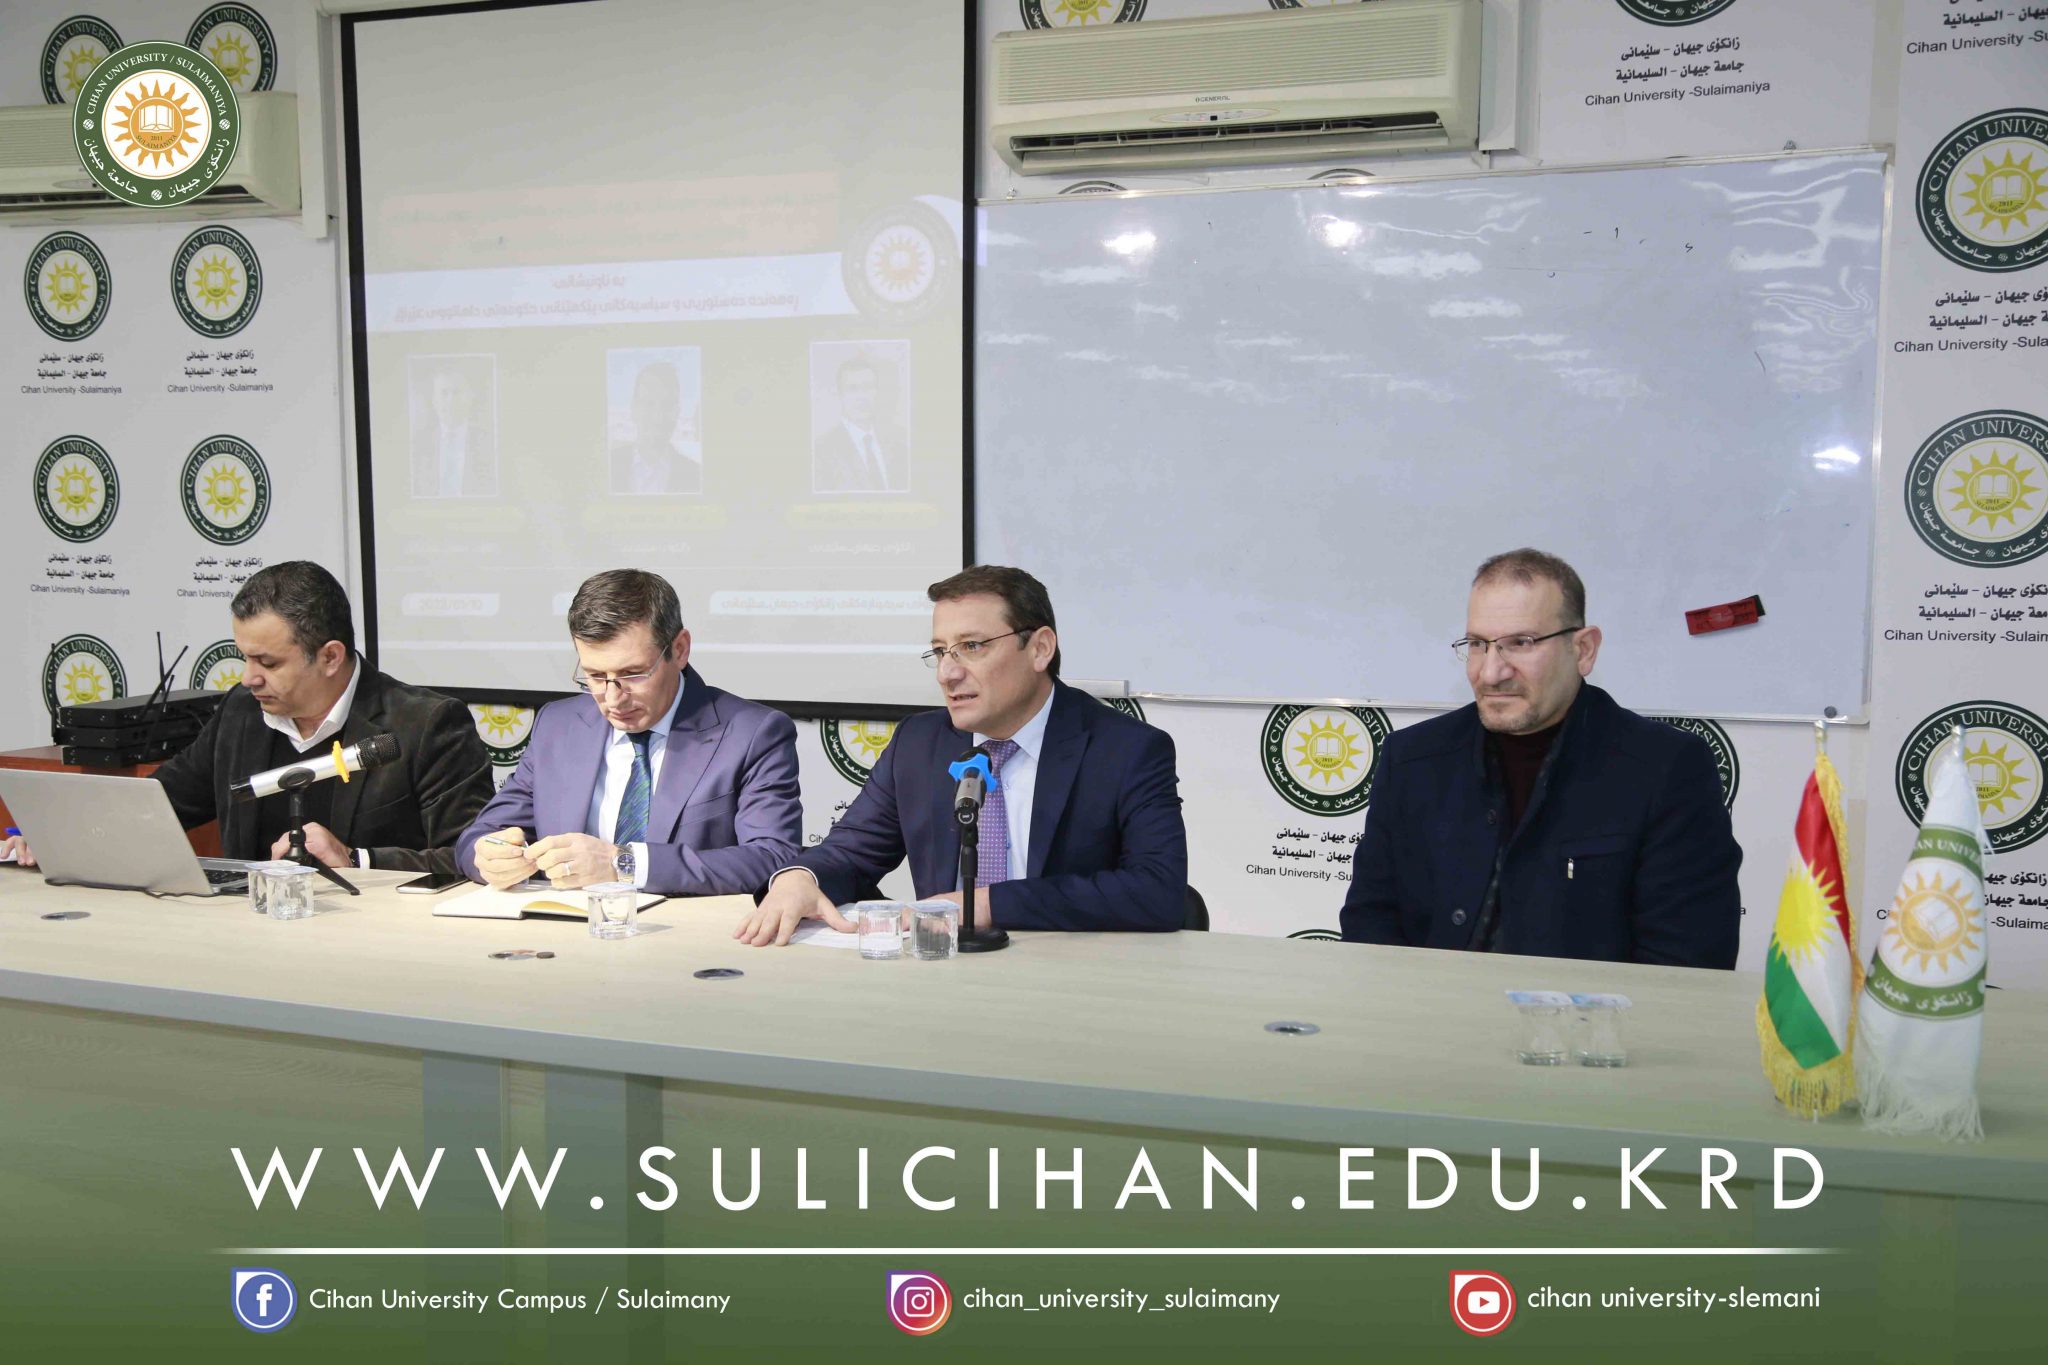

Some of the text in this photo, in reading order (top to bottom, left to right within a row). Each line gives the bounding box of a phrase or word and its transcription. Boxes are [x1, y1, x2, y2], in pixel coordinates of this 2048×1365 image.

[1906, 41, 1947, 54] Cihan
[1951, 33, 2024, 50] University
[1585, 81, 1771, 106] Cihan University -Sulaimaniya
[1929, 118, 2048, 192] CIHAN UNIVE
[53, 237, 107, 283] UNIVERSITY
[201, 231, 257, 276] UNIVERSITY
[1894, 341, 1934, 352] Cihan
[1938, 338, 2008, 351] University
[21, 385, 41, 394] Cihan
[43, 385, 76, 395] University
[167, 385, 188, 393] Cihan
[190, 384, 225, 393] University
[62, 441, 115, 486] UNIVERSITY
[210, 441, 265, 486] UNIVERSITY
[1917, 420, 2048, 486] CIHAN UNIVER
[30, 584, 50, 593] Cihan
[51, 584, 85, 595] University
[177, 589, 234, 599] Cihan University
[1884, 629, 1923, 641] Cihan
[1928, 630, 1996, 644] University
[1270, 705, 1300, 744] CIHA
[1908, 717, 1955, 771] CIHAN
[809, 834, 824, 843] Cih
[1246, 864, 1276, 876] Cihan
[1279, 867, 1331, 881] University
